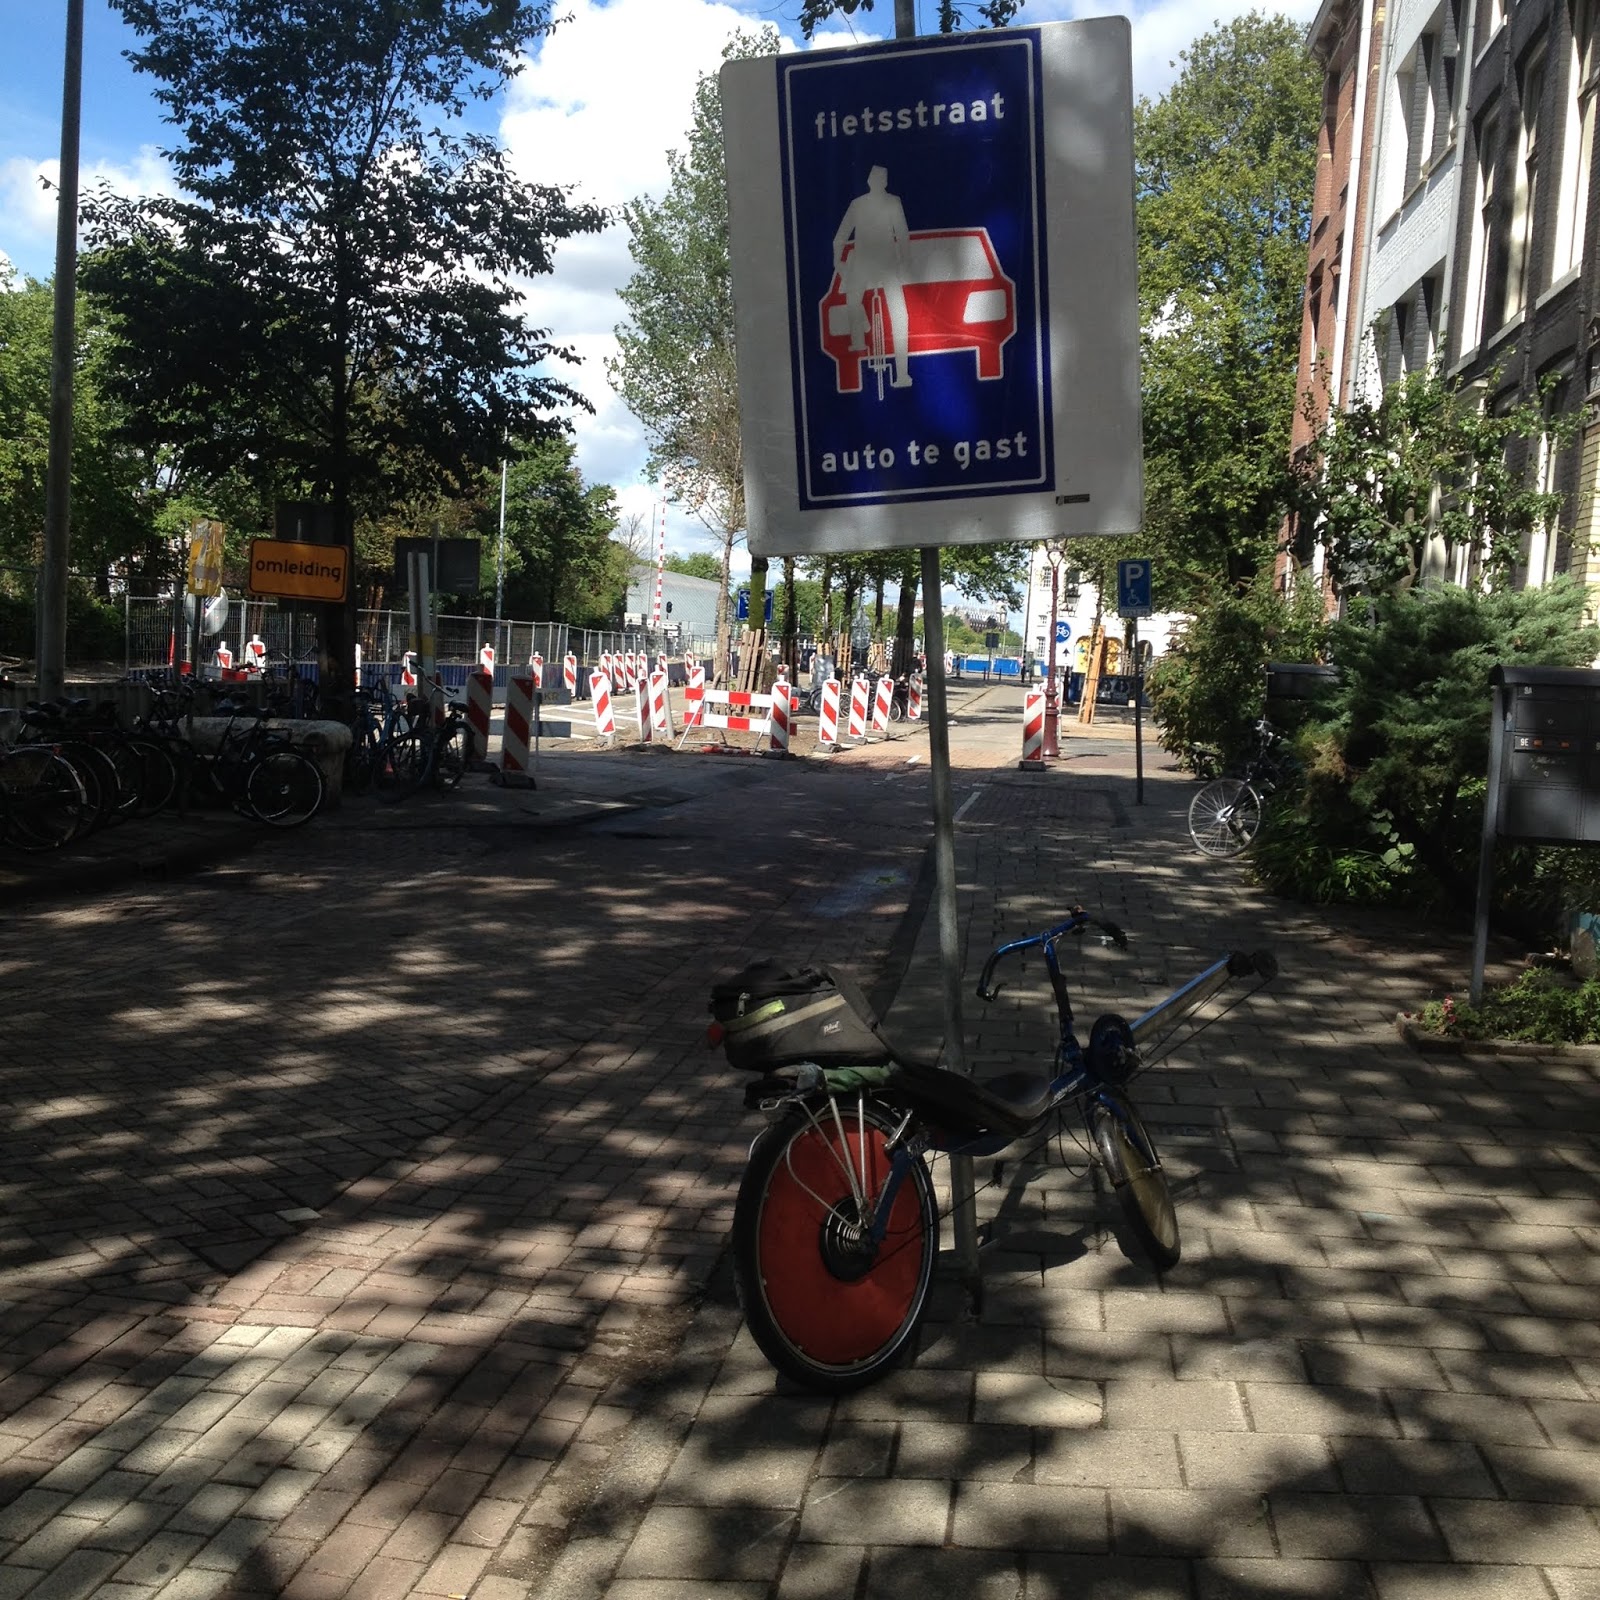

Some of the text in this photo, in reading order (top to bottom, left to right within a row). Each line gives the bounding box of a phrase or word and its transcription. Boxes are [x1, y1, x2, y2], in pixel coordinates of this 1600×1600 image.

[815, 92, 1005, 139] fietsstraat
[821, 431, 1027, 473] auto te gast
[256, 560, 341, 582] omleiding
[1126, 563, 1143, 588] P
